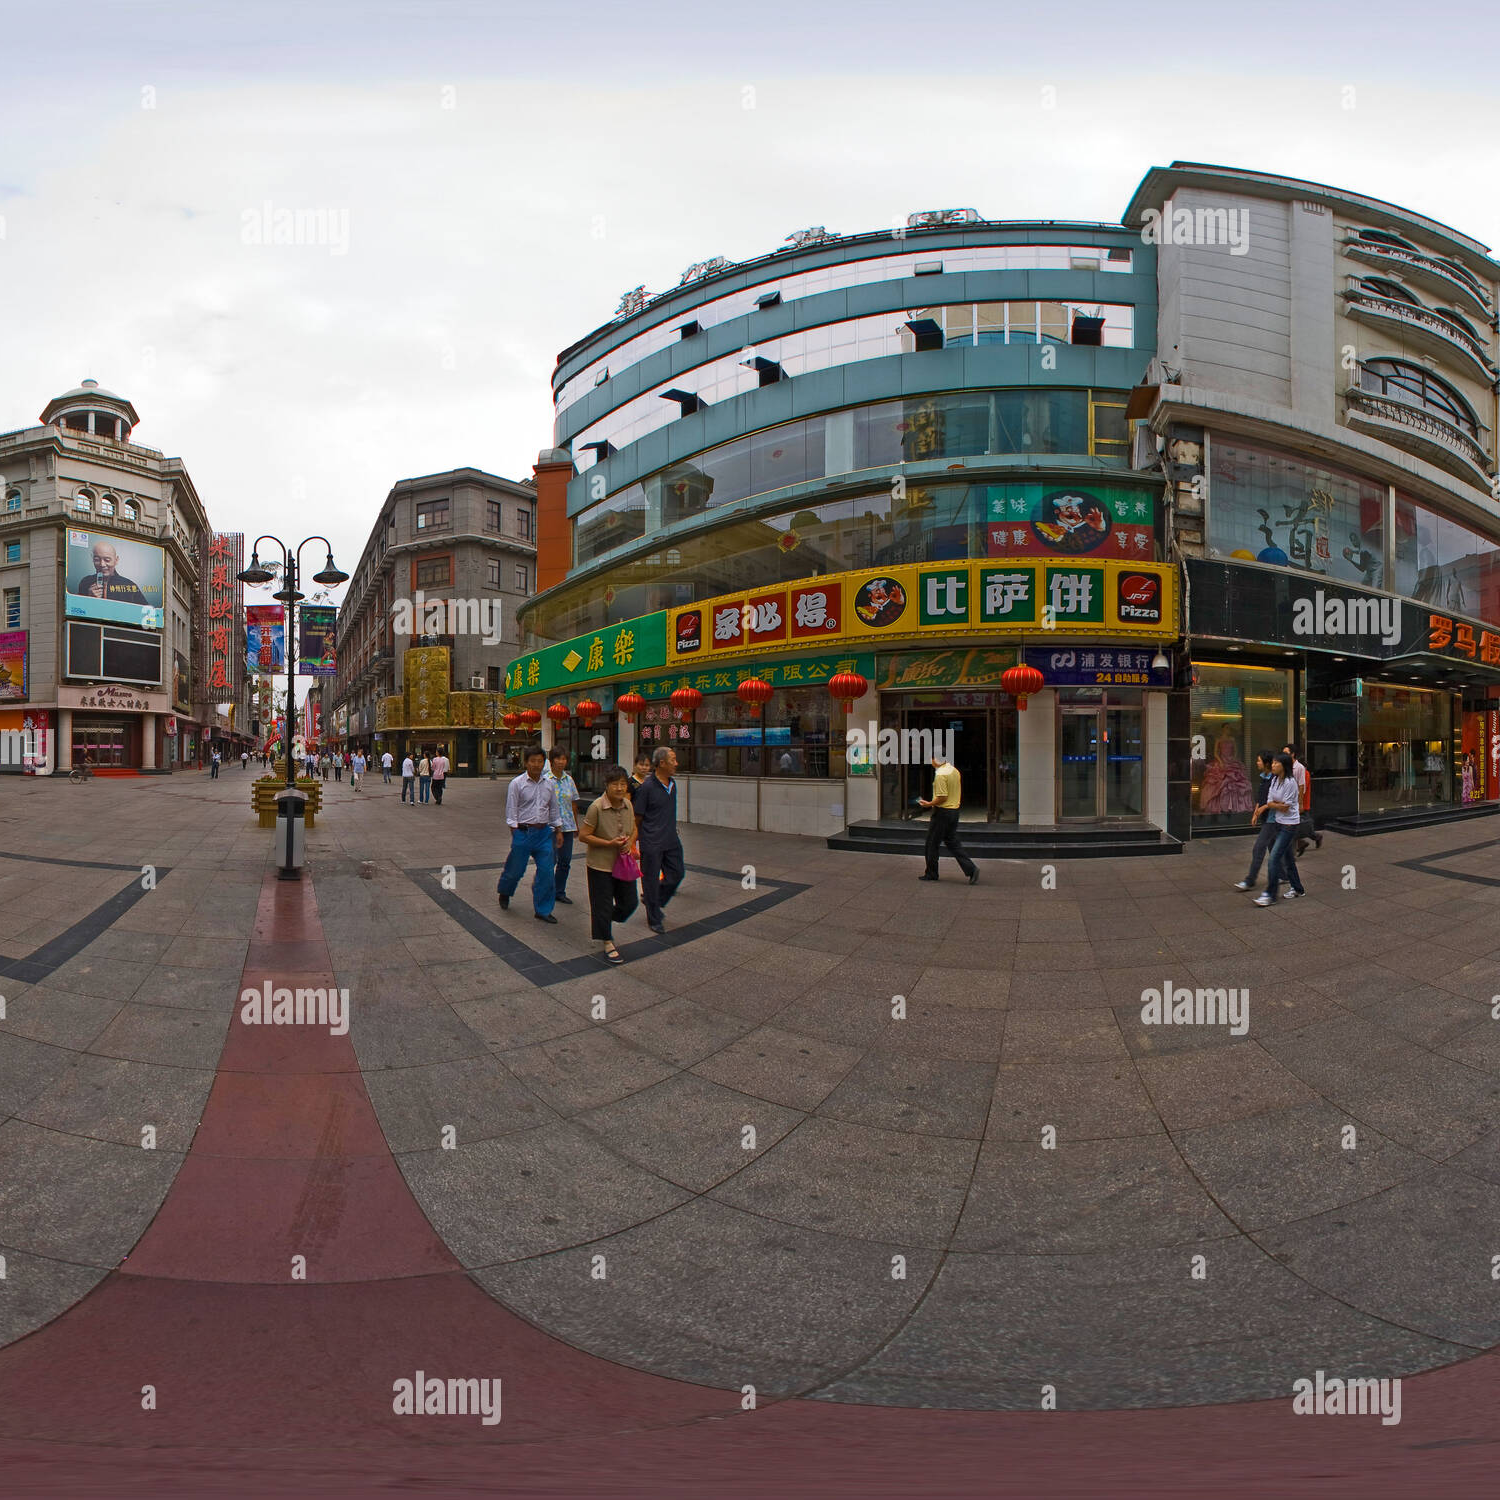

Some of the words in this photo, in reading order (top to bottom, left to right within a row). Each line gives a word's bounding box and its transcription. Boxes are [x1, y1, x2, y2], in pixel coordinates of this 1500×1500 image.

[992, 499, 1028, 515] 美味
[992, 529, 1028, 547] 健康
[924, 573, 1093, 616] 比萨饼
[1125, 593, 1150, 601] JPT
[206, 534, 235, 690] 米莱欧商厦
[1121, 605, 1159, 618] Pizza
[677, 639, 700, 650] Pizza
[1081, 653, 1149, 669] 浦发银行
[1096, 672, 1112, 683] 24
